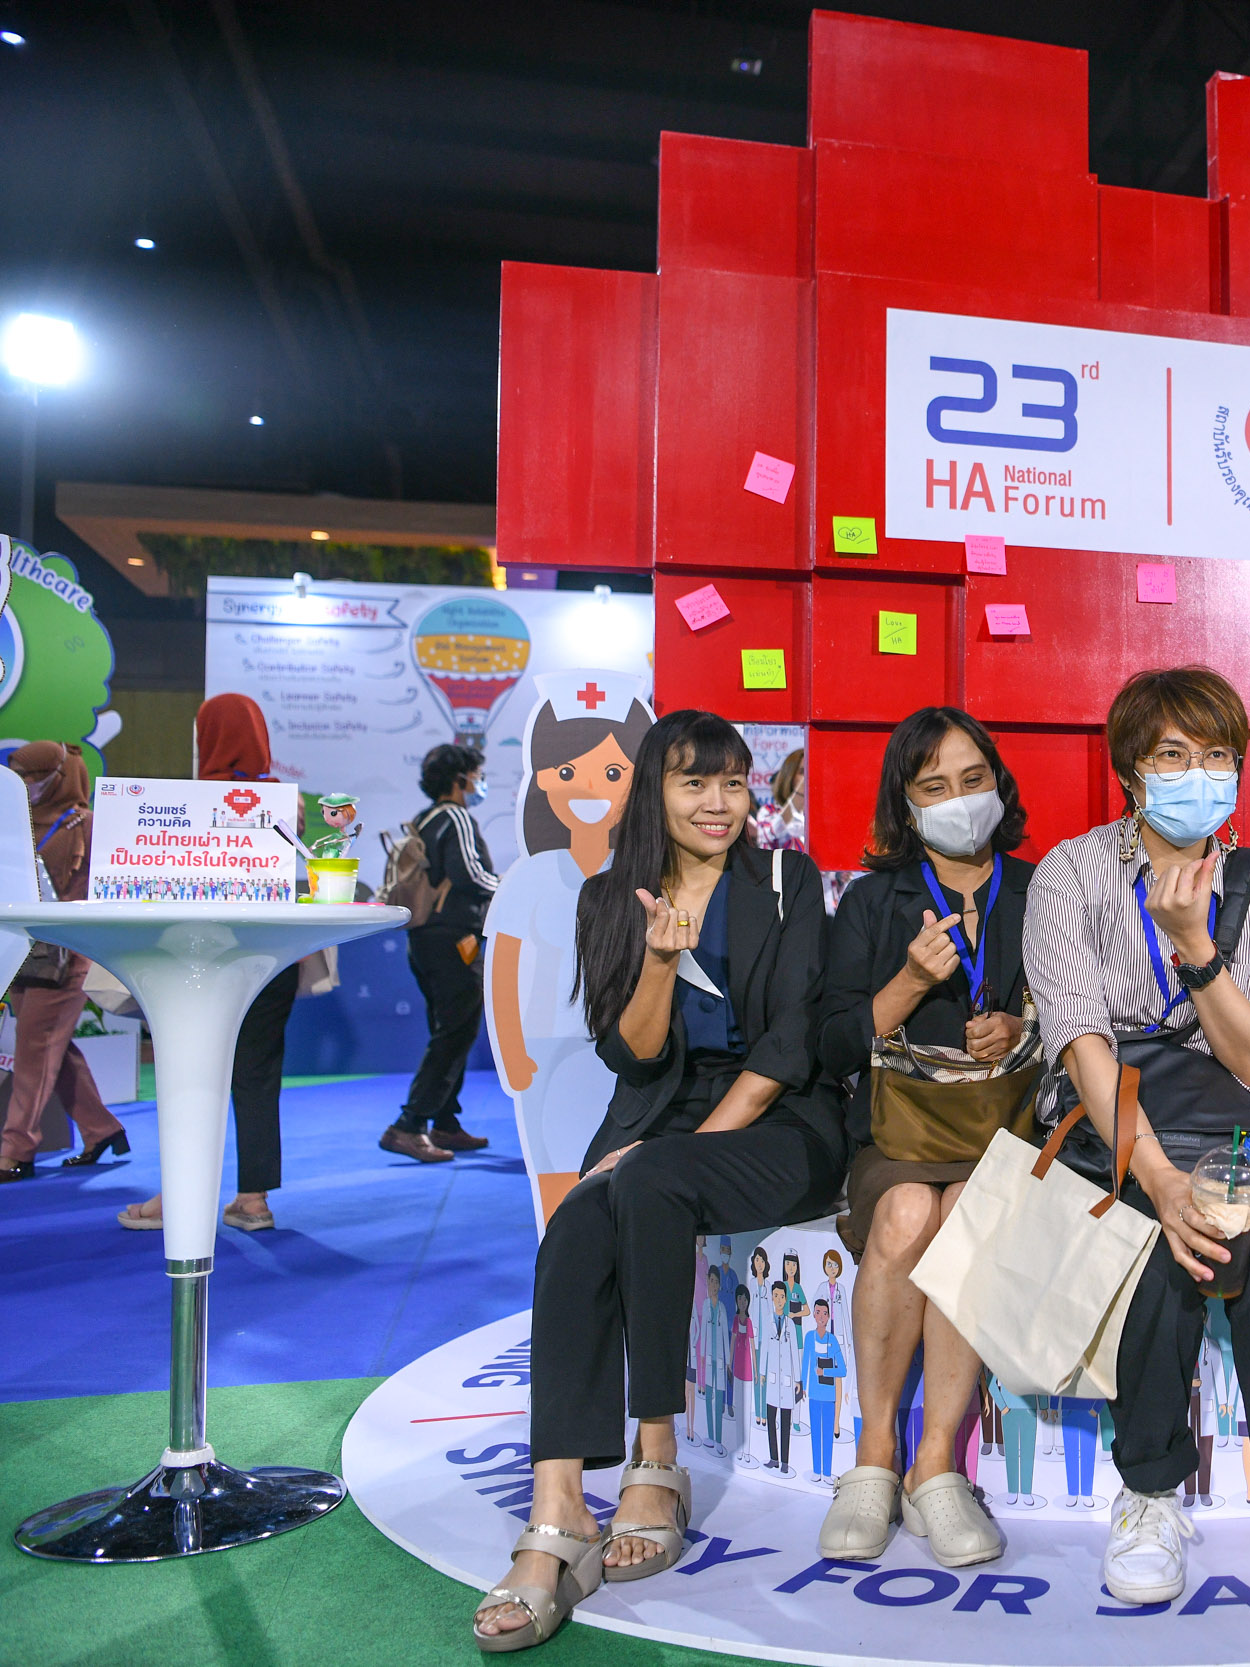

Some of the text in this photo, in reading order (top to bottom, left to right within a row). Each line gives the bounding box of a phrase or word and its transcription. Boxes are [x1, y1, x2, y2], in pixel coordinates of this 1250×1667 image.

[926, 458, 996, 513] HA
[1004, 464, 1072, 487] National
[1004, 485, 1106, 520] Forum
[12, 549, 90, 610] lthcare
[137, 815, 191, 828] ความคิด
[138, 803, 187, 816] ร่วมแชร์
[226, 835, 253, 848] HA
[110, 848, 280, 873] เป็นอย่างไรในใจคุณ?
[772, 1558, 1050, 1616] FOR
